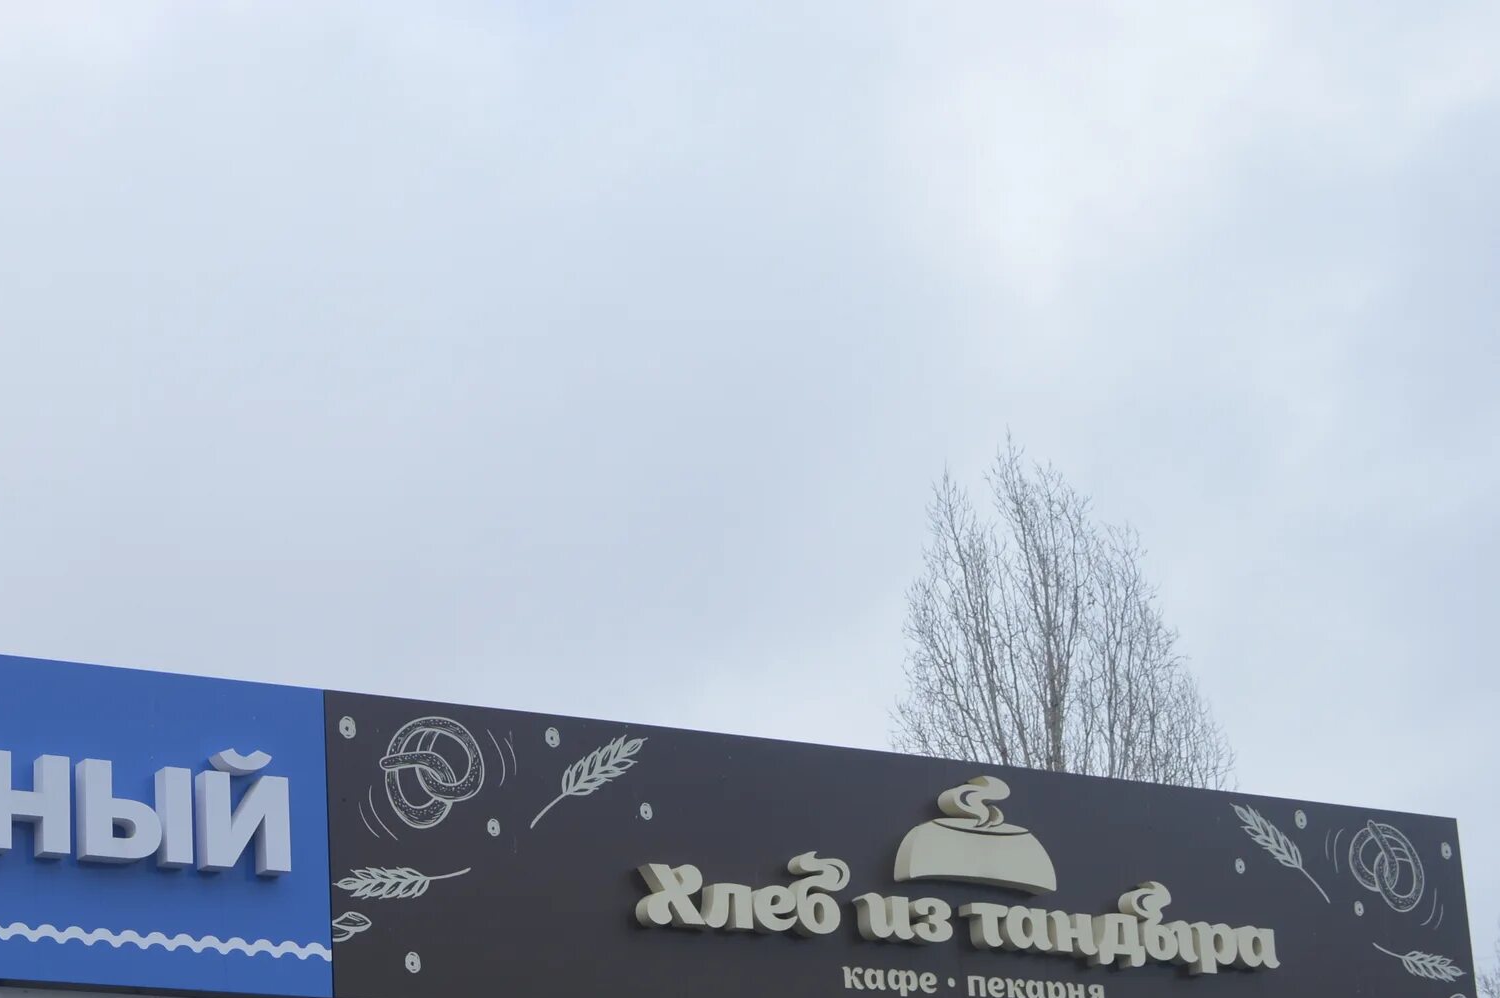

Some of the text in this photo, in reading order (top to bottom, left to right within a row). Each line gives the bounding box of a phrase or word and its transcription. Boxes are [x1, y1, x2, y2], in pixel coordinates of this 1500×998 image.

[634, 851, 1281, 976] Хлеб из тандыра
[842, 961, 938, 998] кафе
